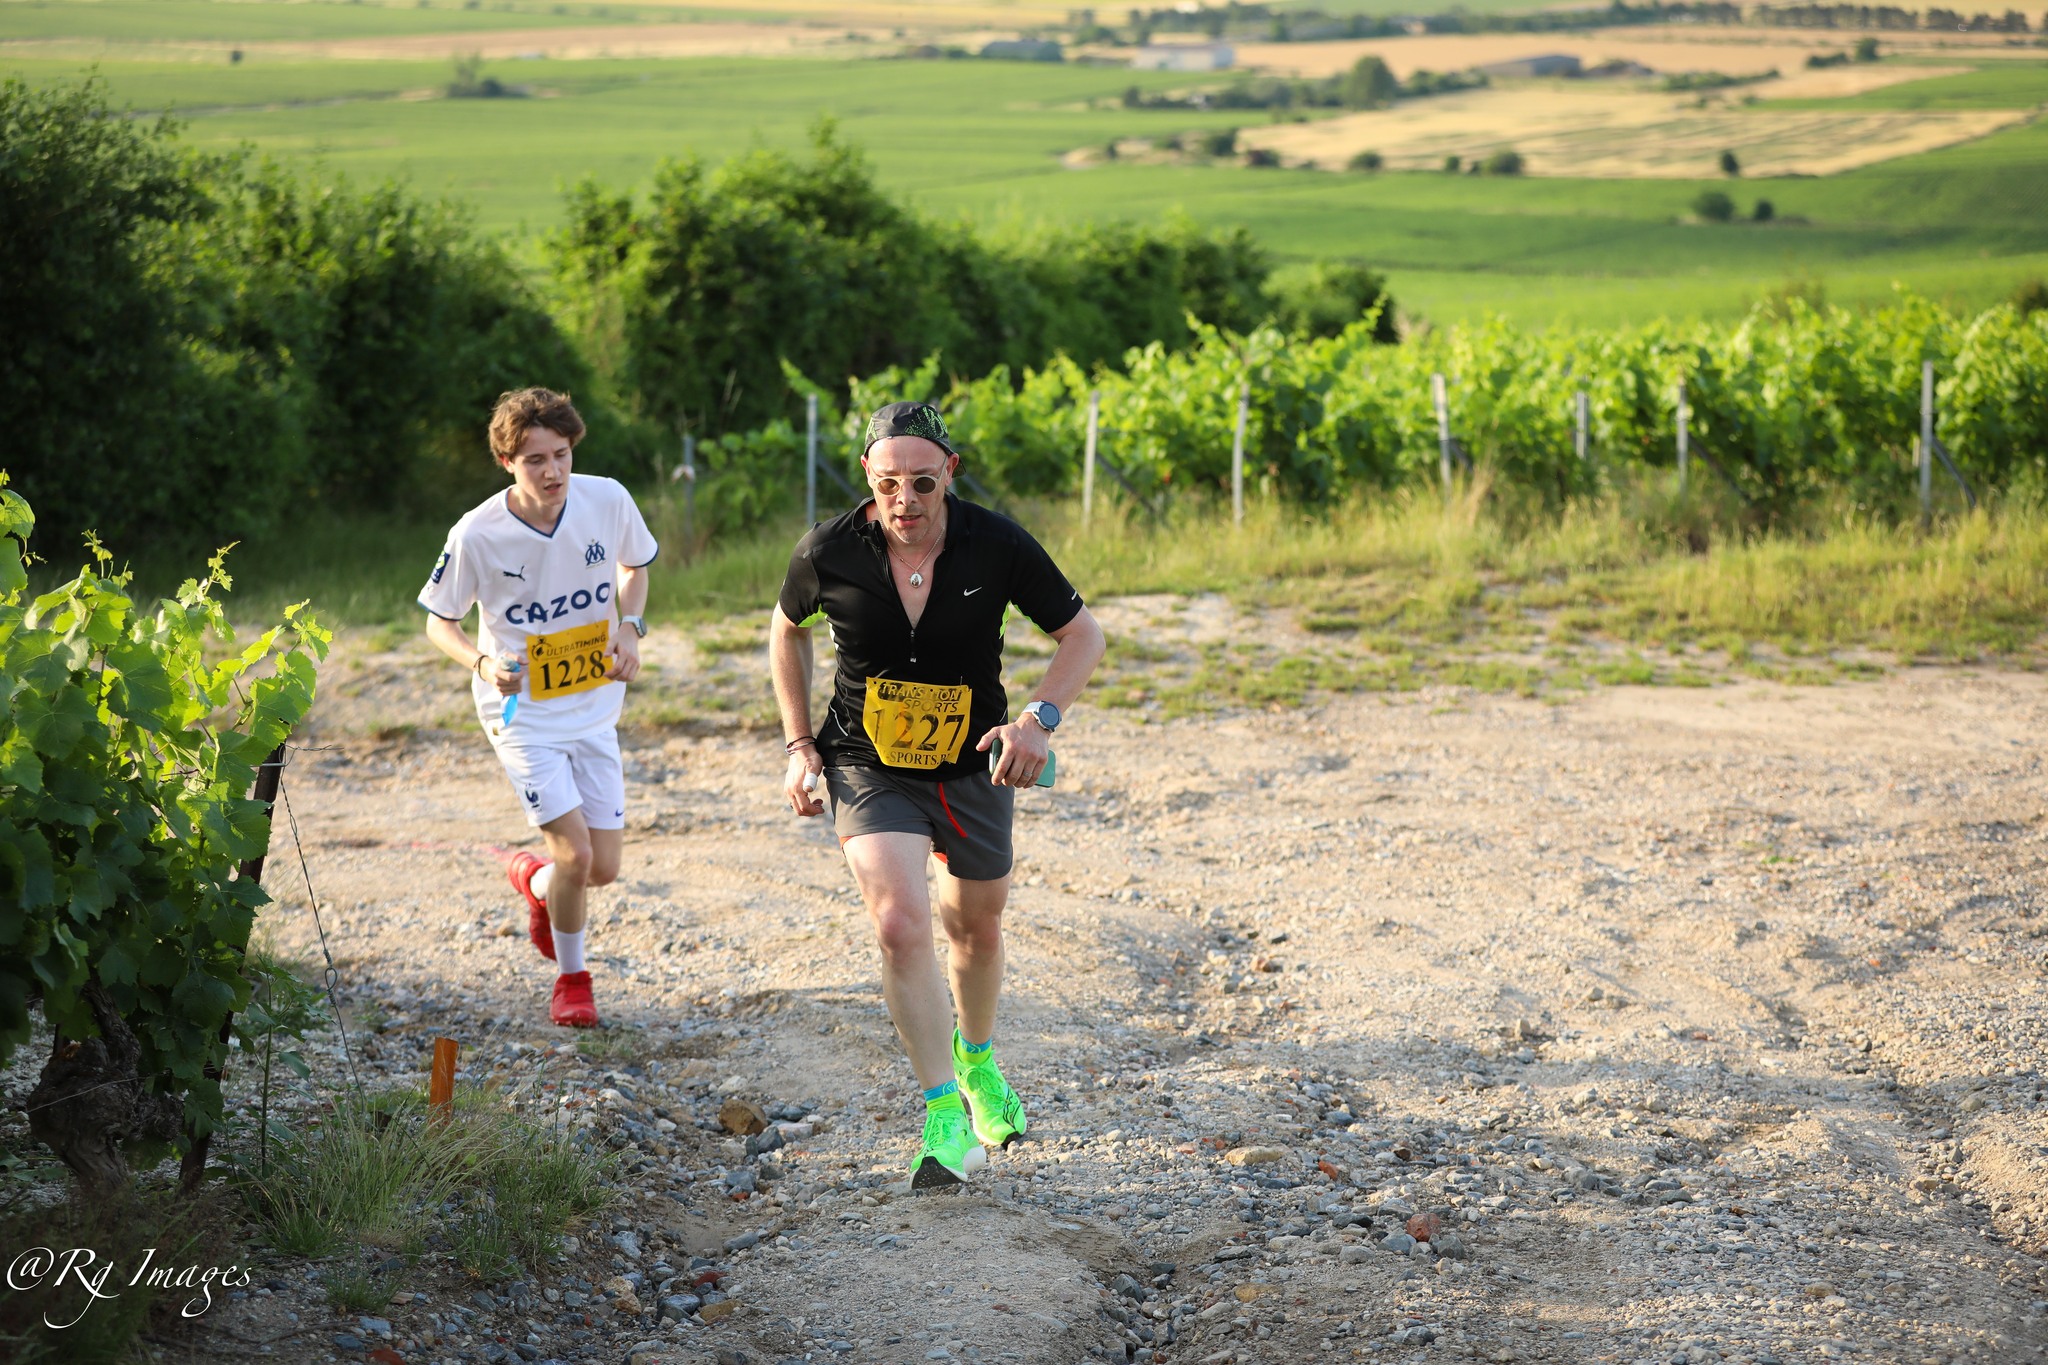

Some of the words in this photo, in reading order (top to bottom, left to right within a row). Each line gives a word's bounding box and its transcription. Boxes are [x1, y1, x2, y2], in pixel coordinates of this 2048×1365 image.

[505, 582, 610, 625] CAZOO
[546, 632, 606, 657] ULTRATIMING
[540, 649, 606, 691] 1228
[903, 698, 959, 713] SPORTS
[872, 708, 965, 752] 1227
